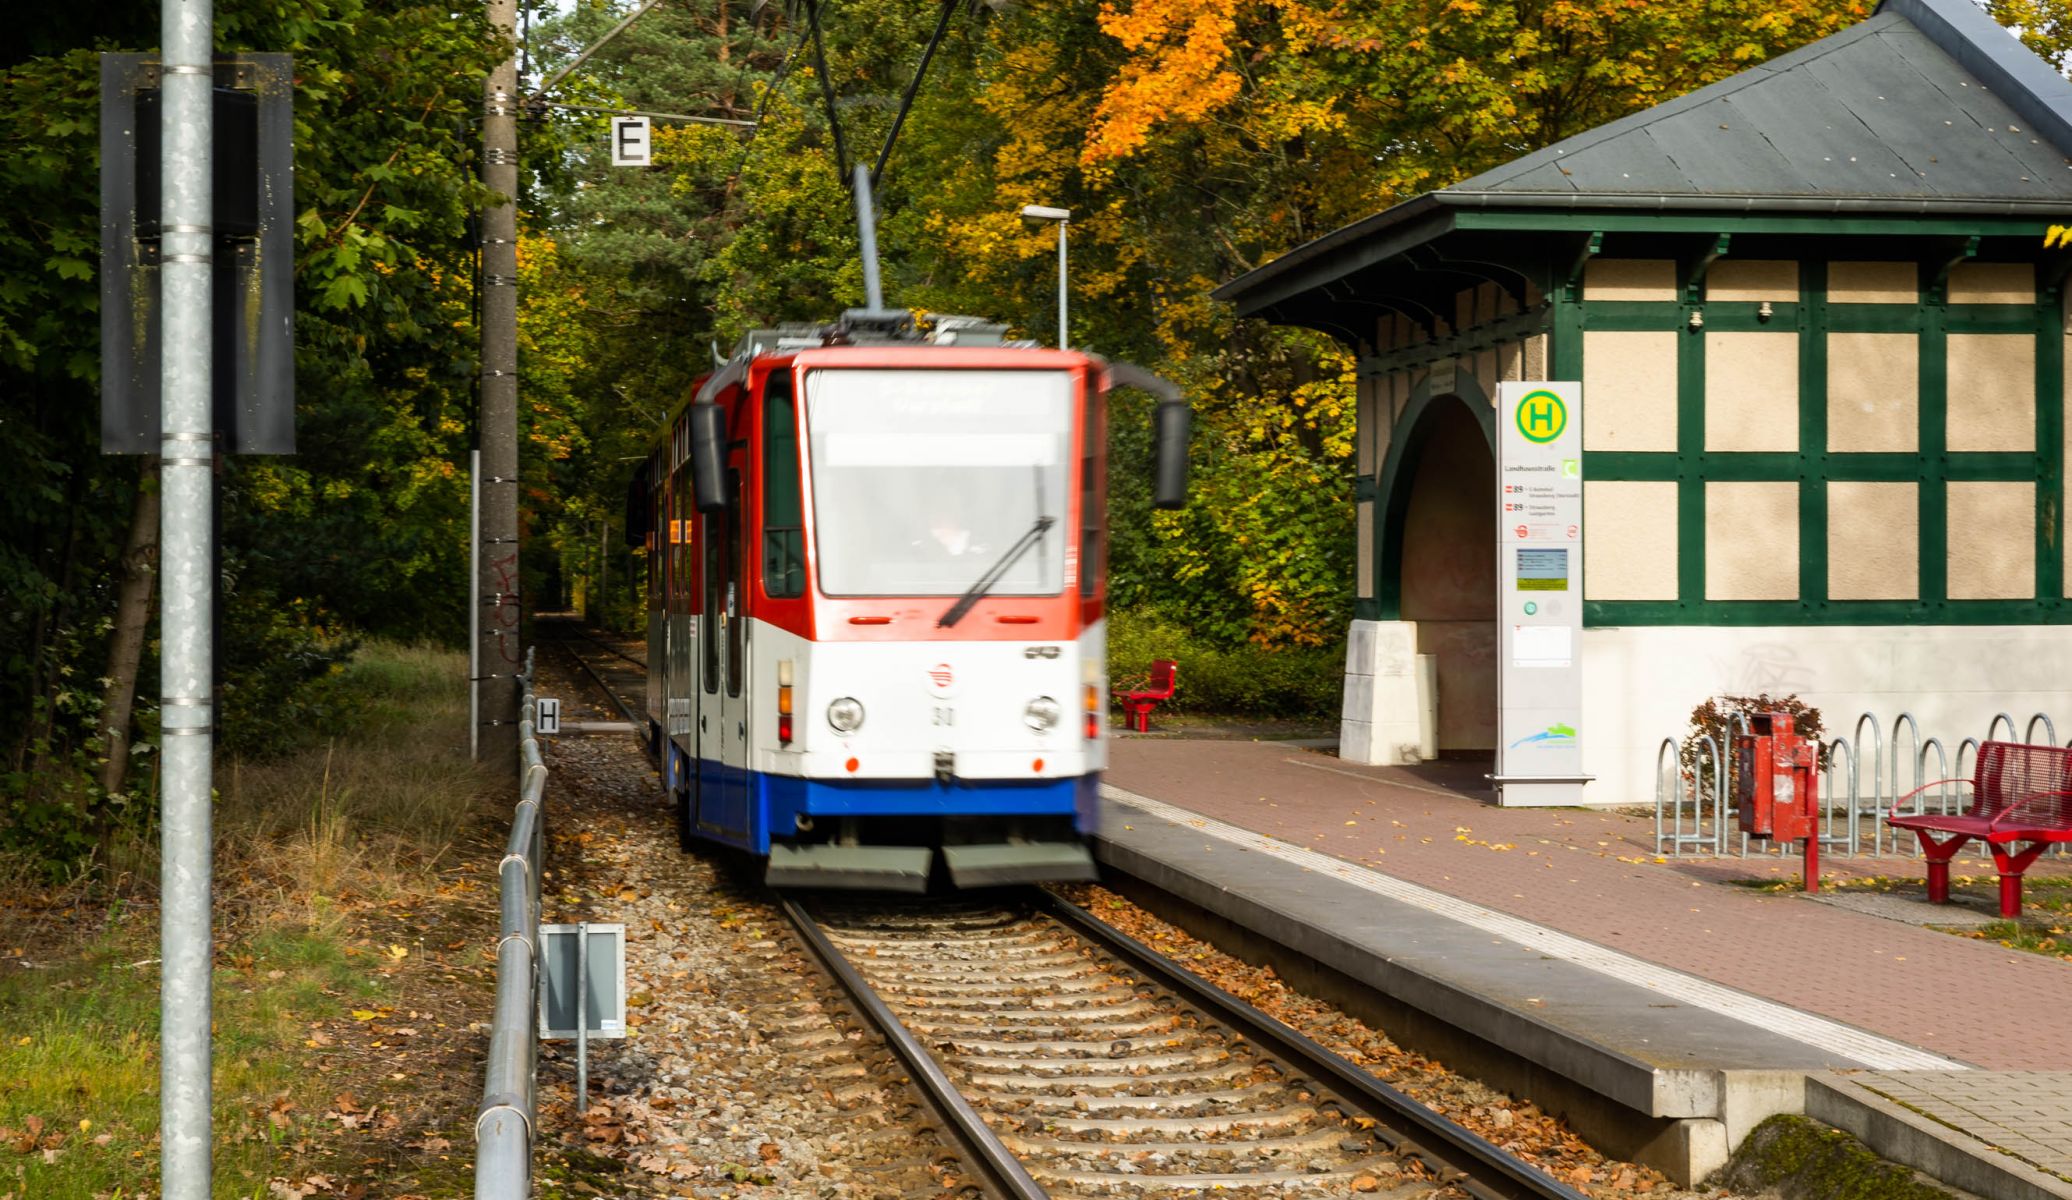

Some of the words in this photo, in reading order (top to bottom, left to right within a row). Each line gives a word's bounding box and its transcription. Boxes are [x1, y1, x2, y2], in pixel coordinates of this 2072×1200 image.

[619, 121, 644, 161] E
[1529, 402, 1553, 431] H
[540, 701, 556, 731] H
